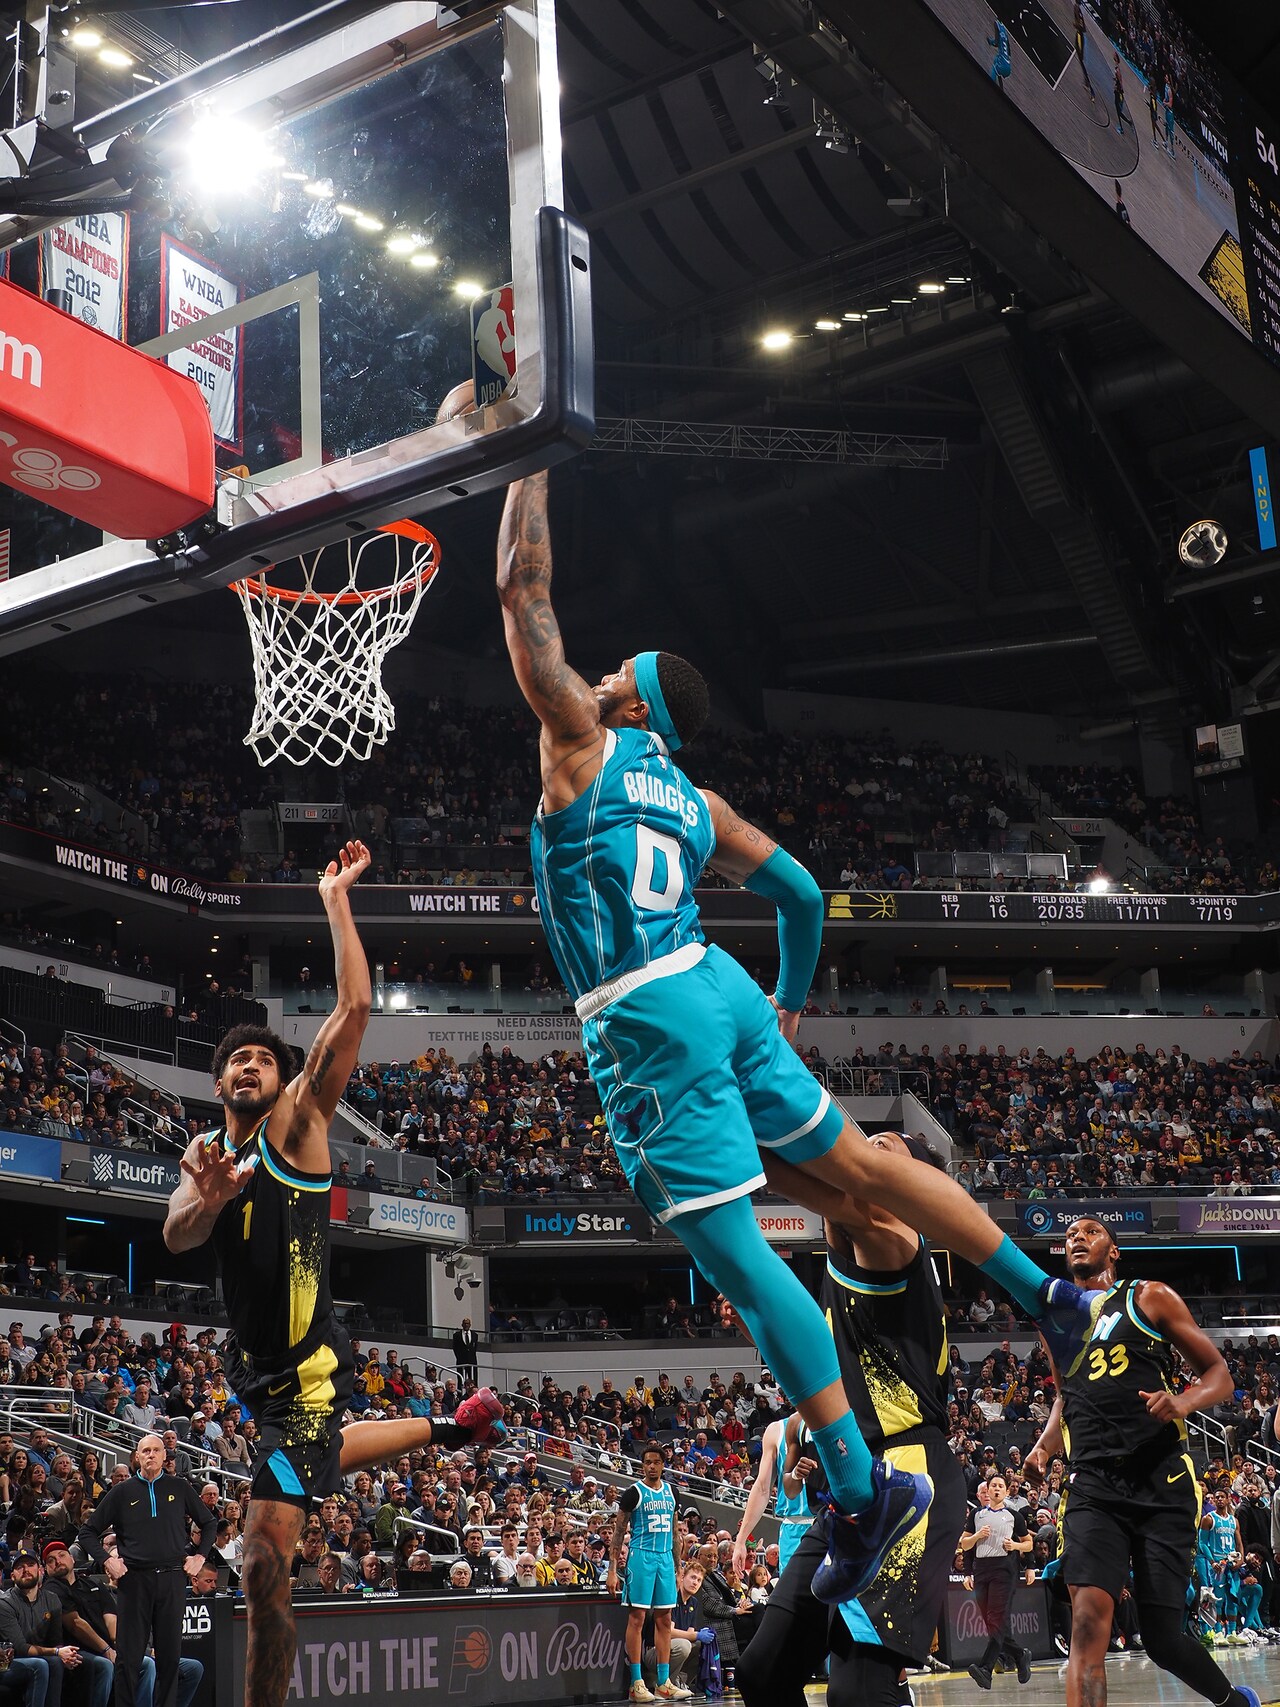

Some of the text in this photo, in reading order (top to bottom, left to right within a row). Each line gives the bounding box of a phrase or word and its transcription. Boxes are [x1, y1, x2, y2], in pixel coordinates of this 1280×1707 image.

[1201, 121, 1229, 164] WATCH
[1256, 126, 1279, 175] 54
[75, 214, 111, 245] NBA
[52, 228, 119, 280] CHAMPIONS
[65, 267, 101, 306] 2012
[183, 268, 224, 309] WNBA
[187, 361, 216, 391] 2015
[481, 379, 502, 403] NBA
[1258, 475, 1269, 522] INDY
[624, 772, 699, 827] BRIDGES
[285, 808, 299, 818] 211
[322, 808, 338, 819] 212
[55, 845, 242, 906] WATCH THE ON Bally SPORTS
[630, 822, 685, 912] 0
[409, 895, 466, 912] WATCH
[469, 895, 500, 912] THE
[941, 895, 959, 903] REB
[989, 895, 1006, 903] AST
[1032, 896, 1087, 904] FIELD GOALS
[1107, 897, 1167, 906] FREE THROWS
[1190, 898, 1238, 906] 3-POINT FG
[942, 904, 960, 918] 17
[989, 904, 1009, 918] 16
[1037, 905, 1084, 919] 20/35
[1116, 906, 1160, 920] 11/11
[1196, 907, 1233, 921] 7/19
[293, 1023, 298, 1035] 7
[497, 1018, 583, 1028] NEED ASSISTAN
[851, 1024, 856, 1036] 8
[1240, 1025, 1246, 1037] 8
[428, 1030, 580, 1042] TEXT THE ISSUE & LOCATION
[117, 1159, 165, 1185] Ruoff
[242, 1200, 253, 1240] 1
[380, 1201, 456, 1231] salesforce
[525, 1213, 631, 1236] IndyStar.
[760, 1217, 805, 1231] SPORTS
[1096, 1211, 1123, 1222] Tech
[1125, 1211, 1145, 1222] HQ
[1088, 1344, 1129, 1380] 33
[644, 1500, 674, 1512] HORNETS
[647, 1514, 671, 1533] 25
[1220, 1536, 1233, 1550] 14
[1010, 1611, 1039, 1635] PORTS
[285, 1622, 623, 1699] ATCH THE ON Bally
